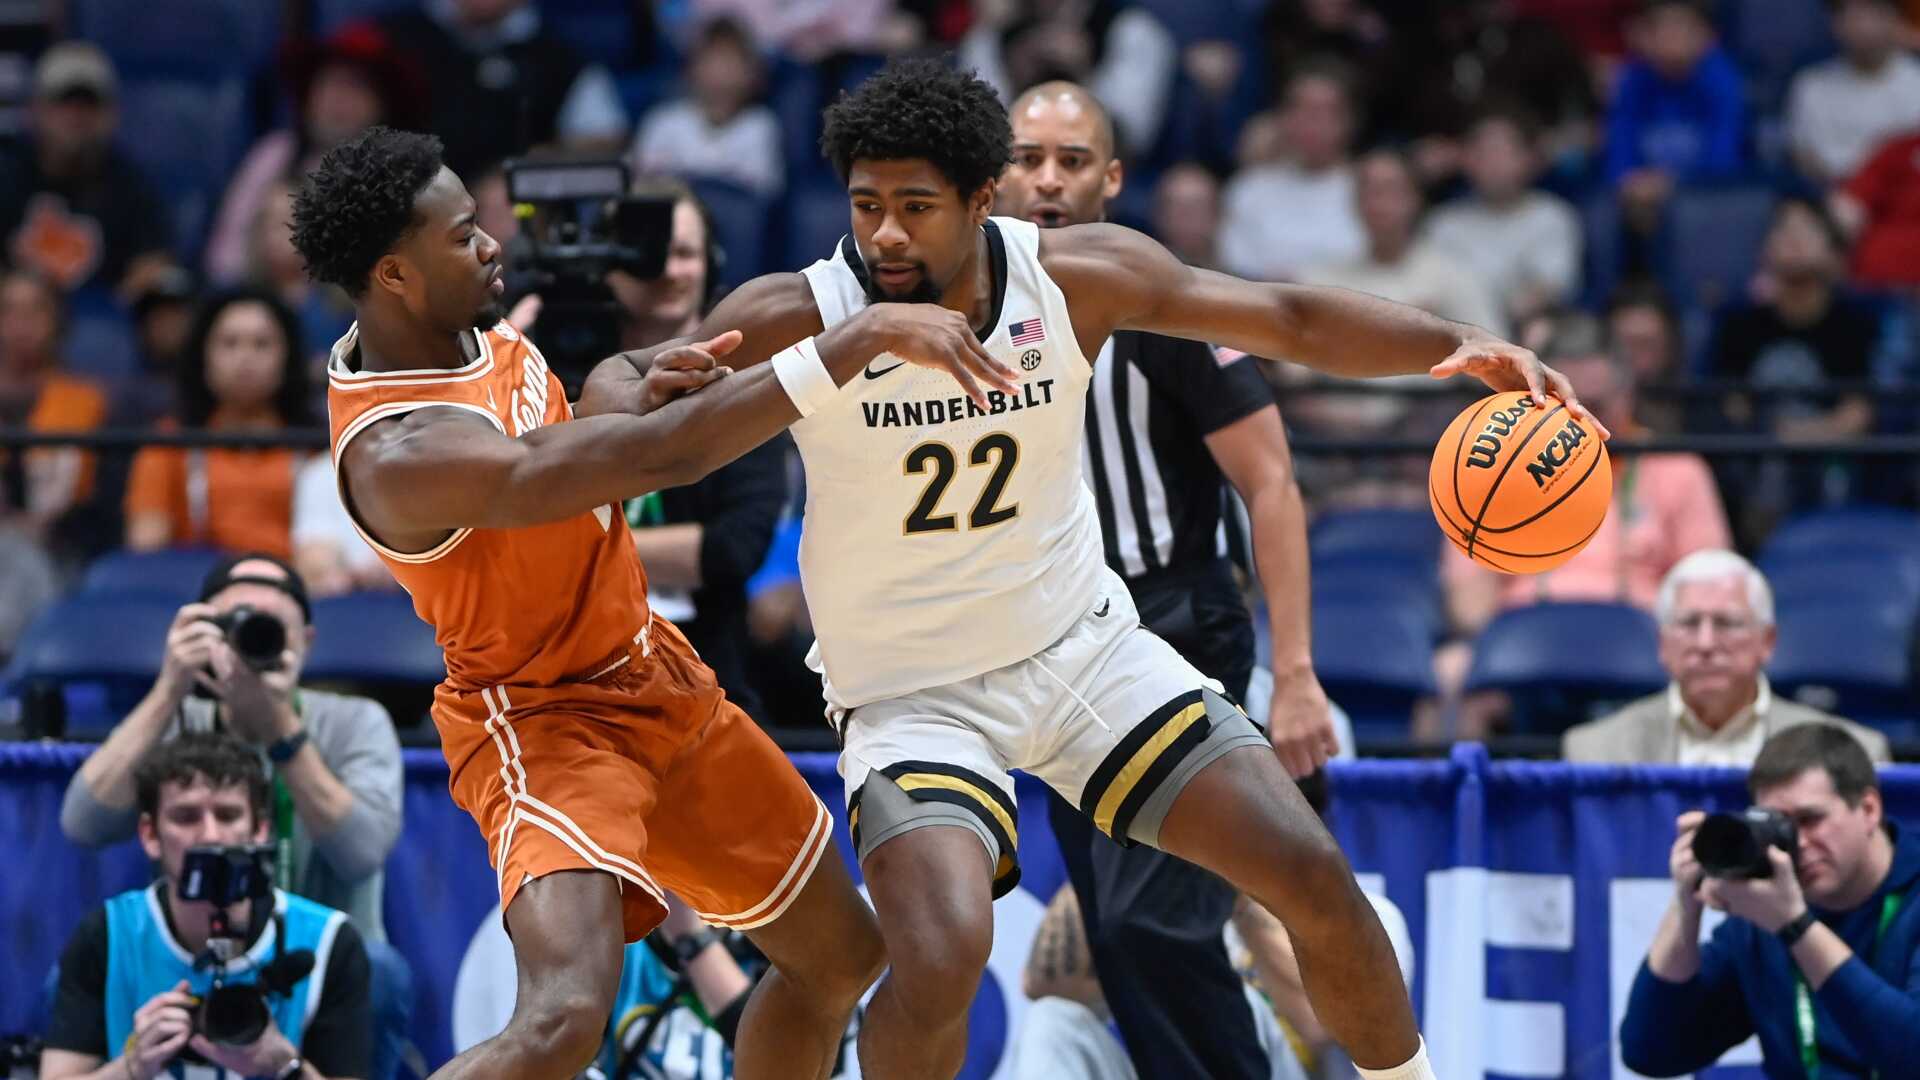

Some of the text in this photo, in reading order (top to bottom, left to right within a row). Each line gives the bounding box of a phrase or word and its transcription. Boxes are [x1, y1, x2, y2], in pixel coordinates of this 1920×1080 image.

[1021, 349, 1042, 371] SEC
[1465, 394, 1537, 470] Wilso
[1525, 418, 1588, 489] NCAA
[902, 430, 1022, 536] 22
